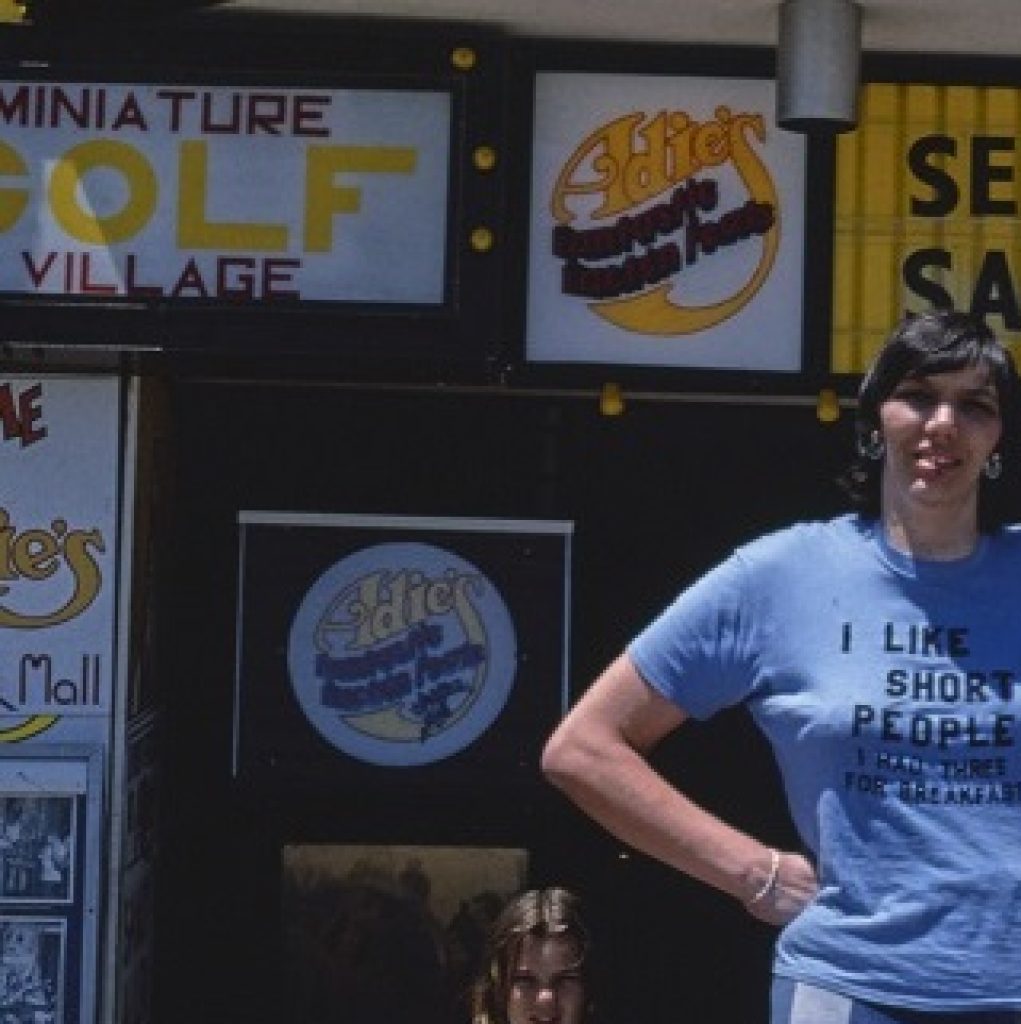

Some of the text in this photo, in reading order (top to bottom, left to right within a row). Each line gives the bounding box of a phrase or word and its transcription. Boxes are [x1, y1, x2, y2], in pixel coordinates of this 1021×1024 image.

[0, 85, 332, 137] MINIATURE
[0, 137, 417, 253] OLF
[22, 251, 301, 299] VILLAGE
[842, 621, 970, 658] I LIKE
[19, 654, 100, 706] Mall
[886, 669, 1015, 702] SHORT
[852, 704, 1015, 749] PEOPLE
